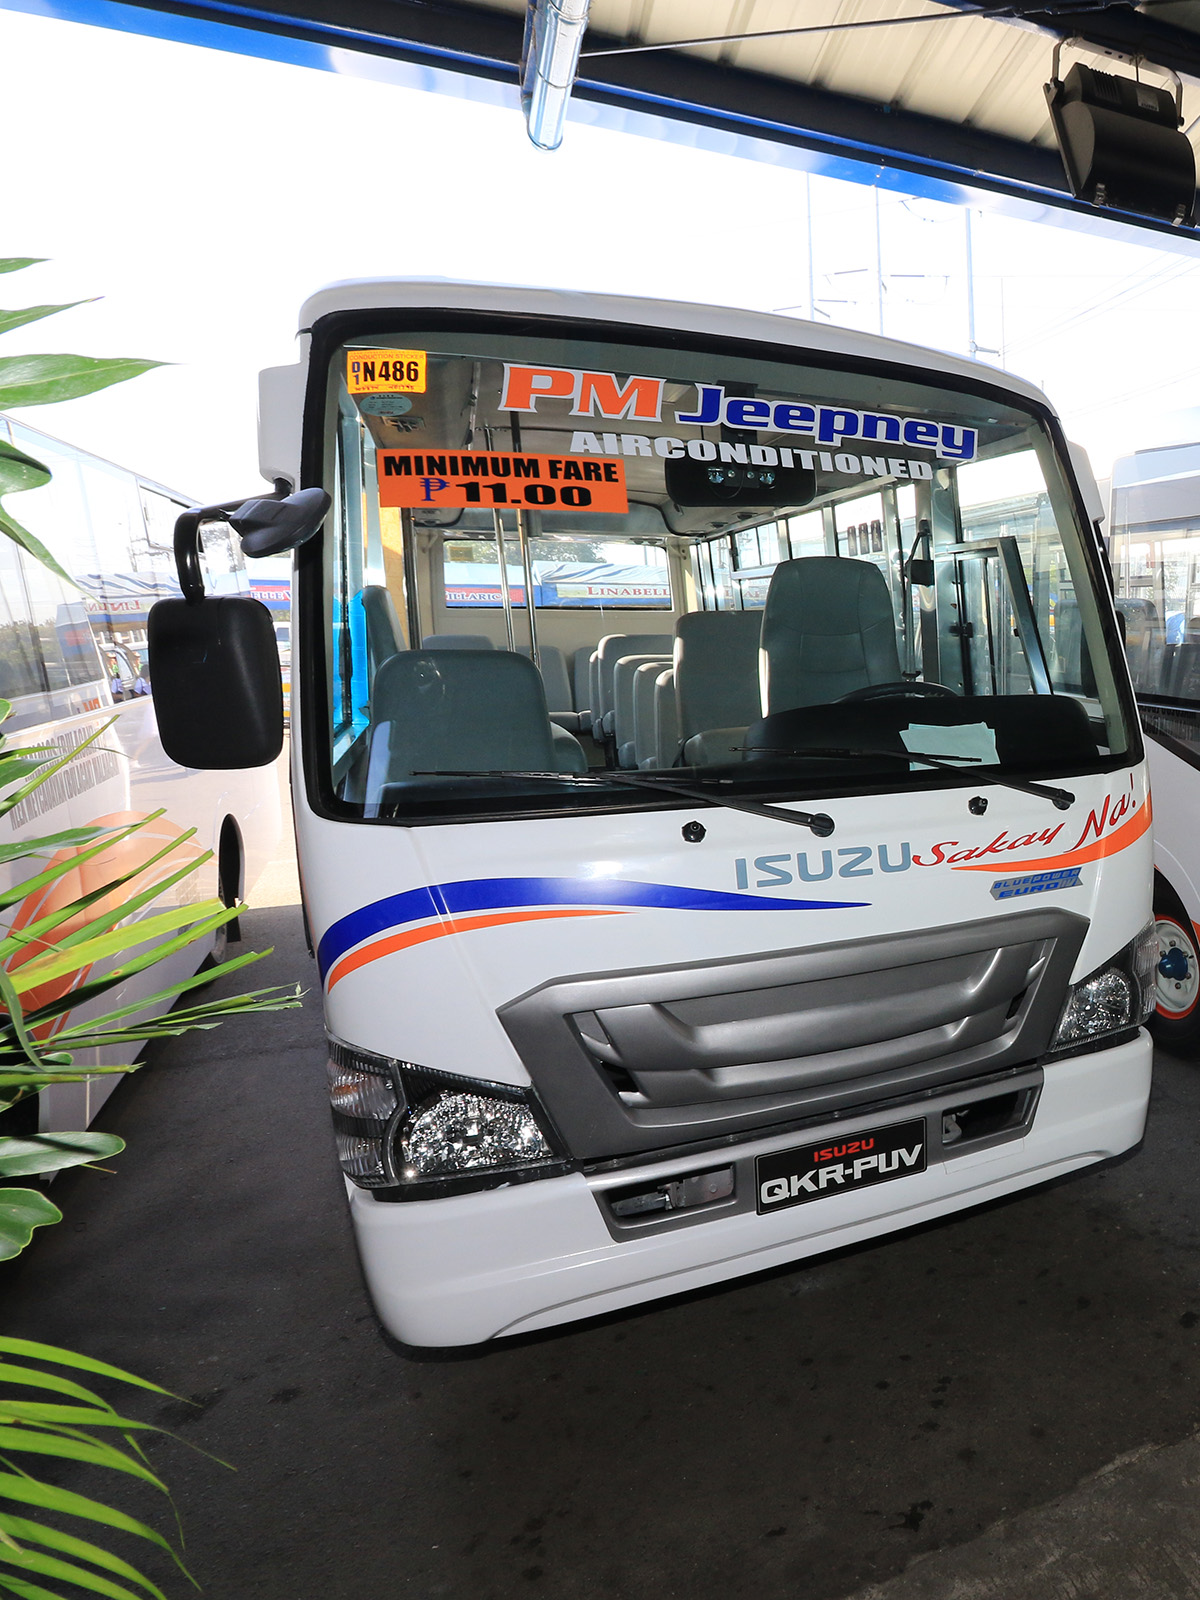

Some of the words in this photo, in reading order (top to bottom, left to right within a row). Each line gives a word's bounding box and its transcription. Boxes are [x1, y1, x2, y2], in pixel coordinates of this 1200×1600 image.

[363, 361, 419, 382] N486
[498, 363, 667, 422] PM
[675, 383, 979, 462] Jeepney
[384, 455, 540, 478] MINIMUM
[548, 459, 619, 483] FARE
[570, 431, 934, 480] AIRCONDITIONED
[912, 822, 1066, 867] Sakay
[1063, 773, 1138, 853] Na!
[735, 842, 911, 890] ISUZU
[761, 1143, 923, 1204] QKR-PUV
[814, 1138, 874, 1162] ISUZU
